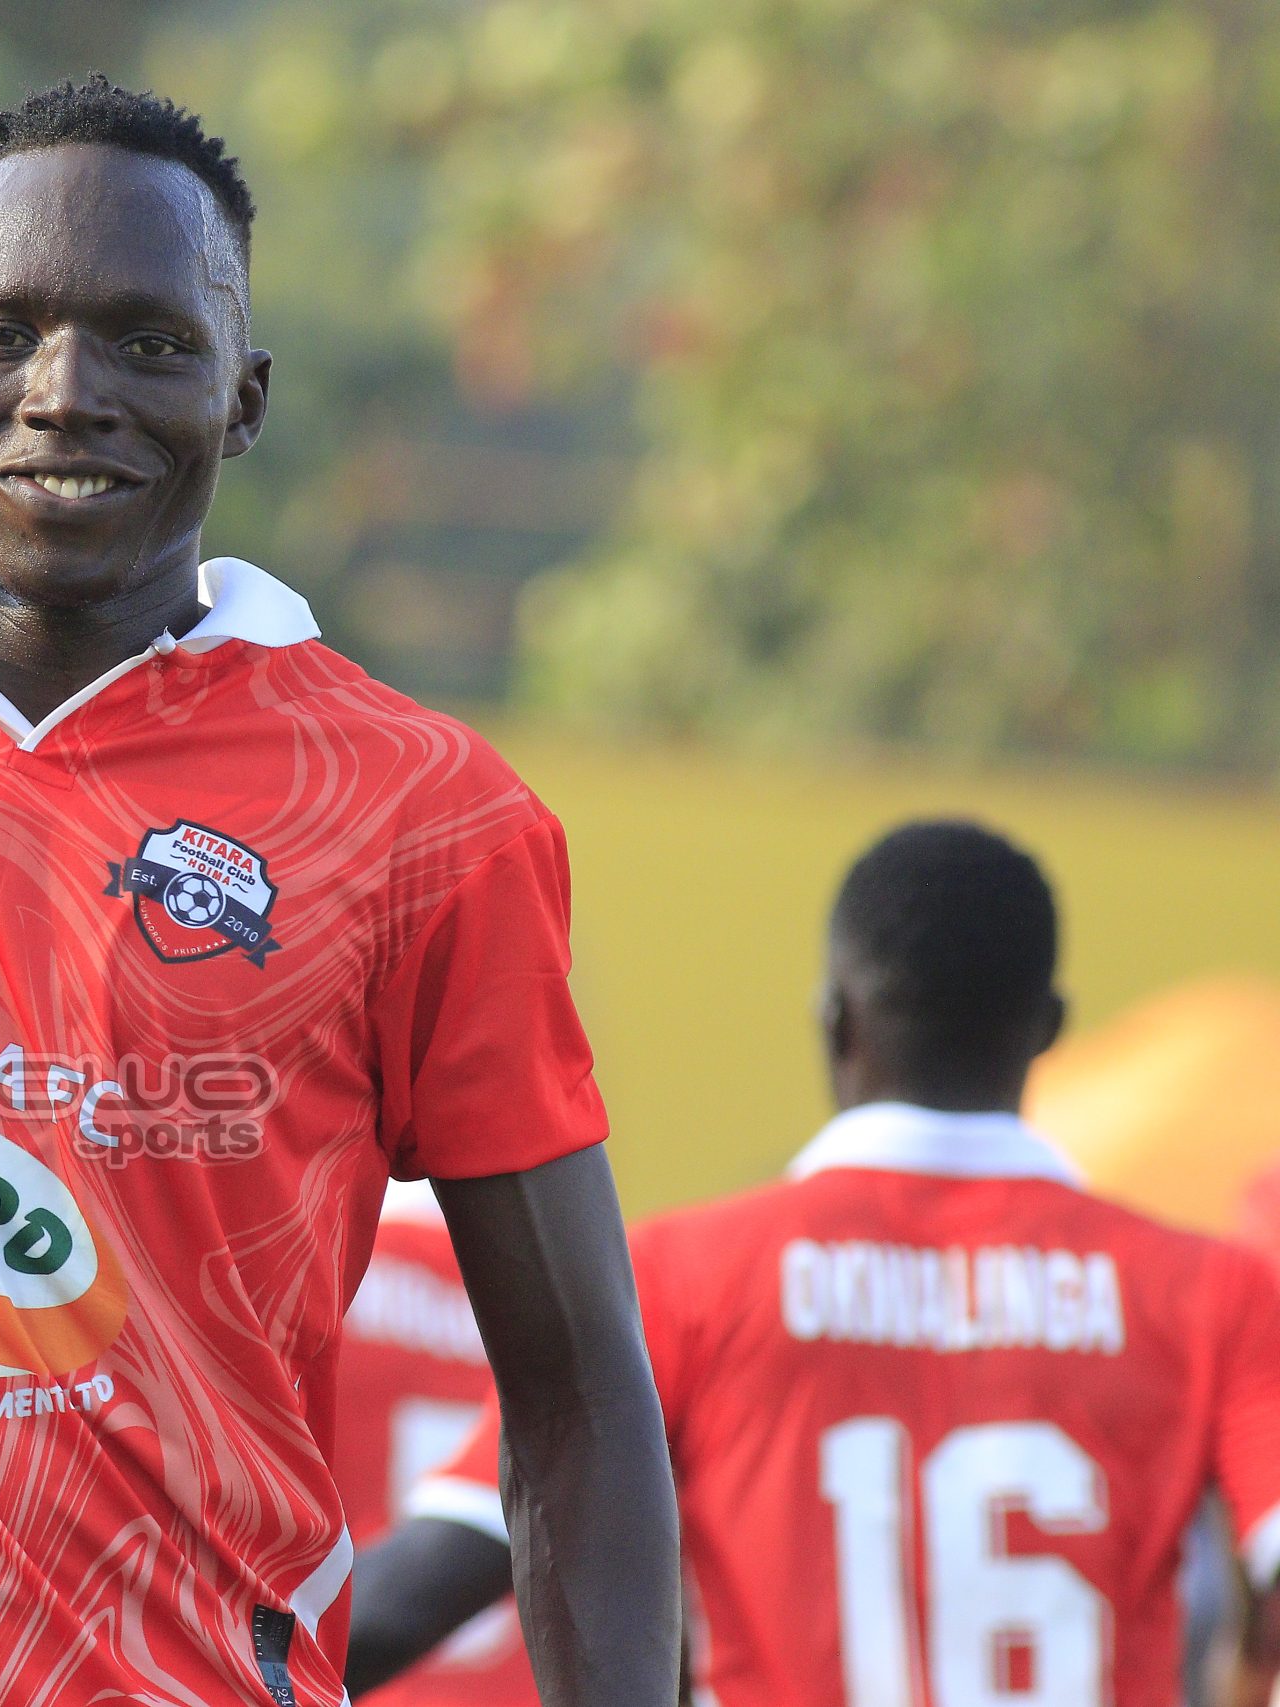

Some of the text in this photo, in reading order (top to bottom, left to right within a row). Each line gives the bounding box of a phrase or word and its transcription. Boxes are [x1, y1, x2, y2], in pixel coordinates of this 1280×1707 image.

[172, 839, 256, 886] Football Club
[181, 827, 253, 873] KITARA
[131, 868, 158, 887] Est.
[187, 858, 231, 886] HOIMA
[224, 916, 258, 943] 2010
[174, 946, 203, 956] PRIDE
[47, 1064, 124, 1148] FC
[819, 1415, 1116, 1707] 16
